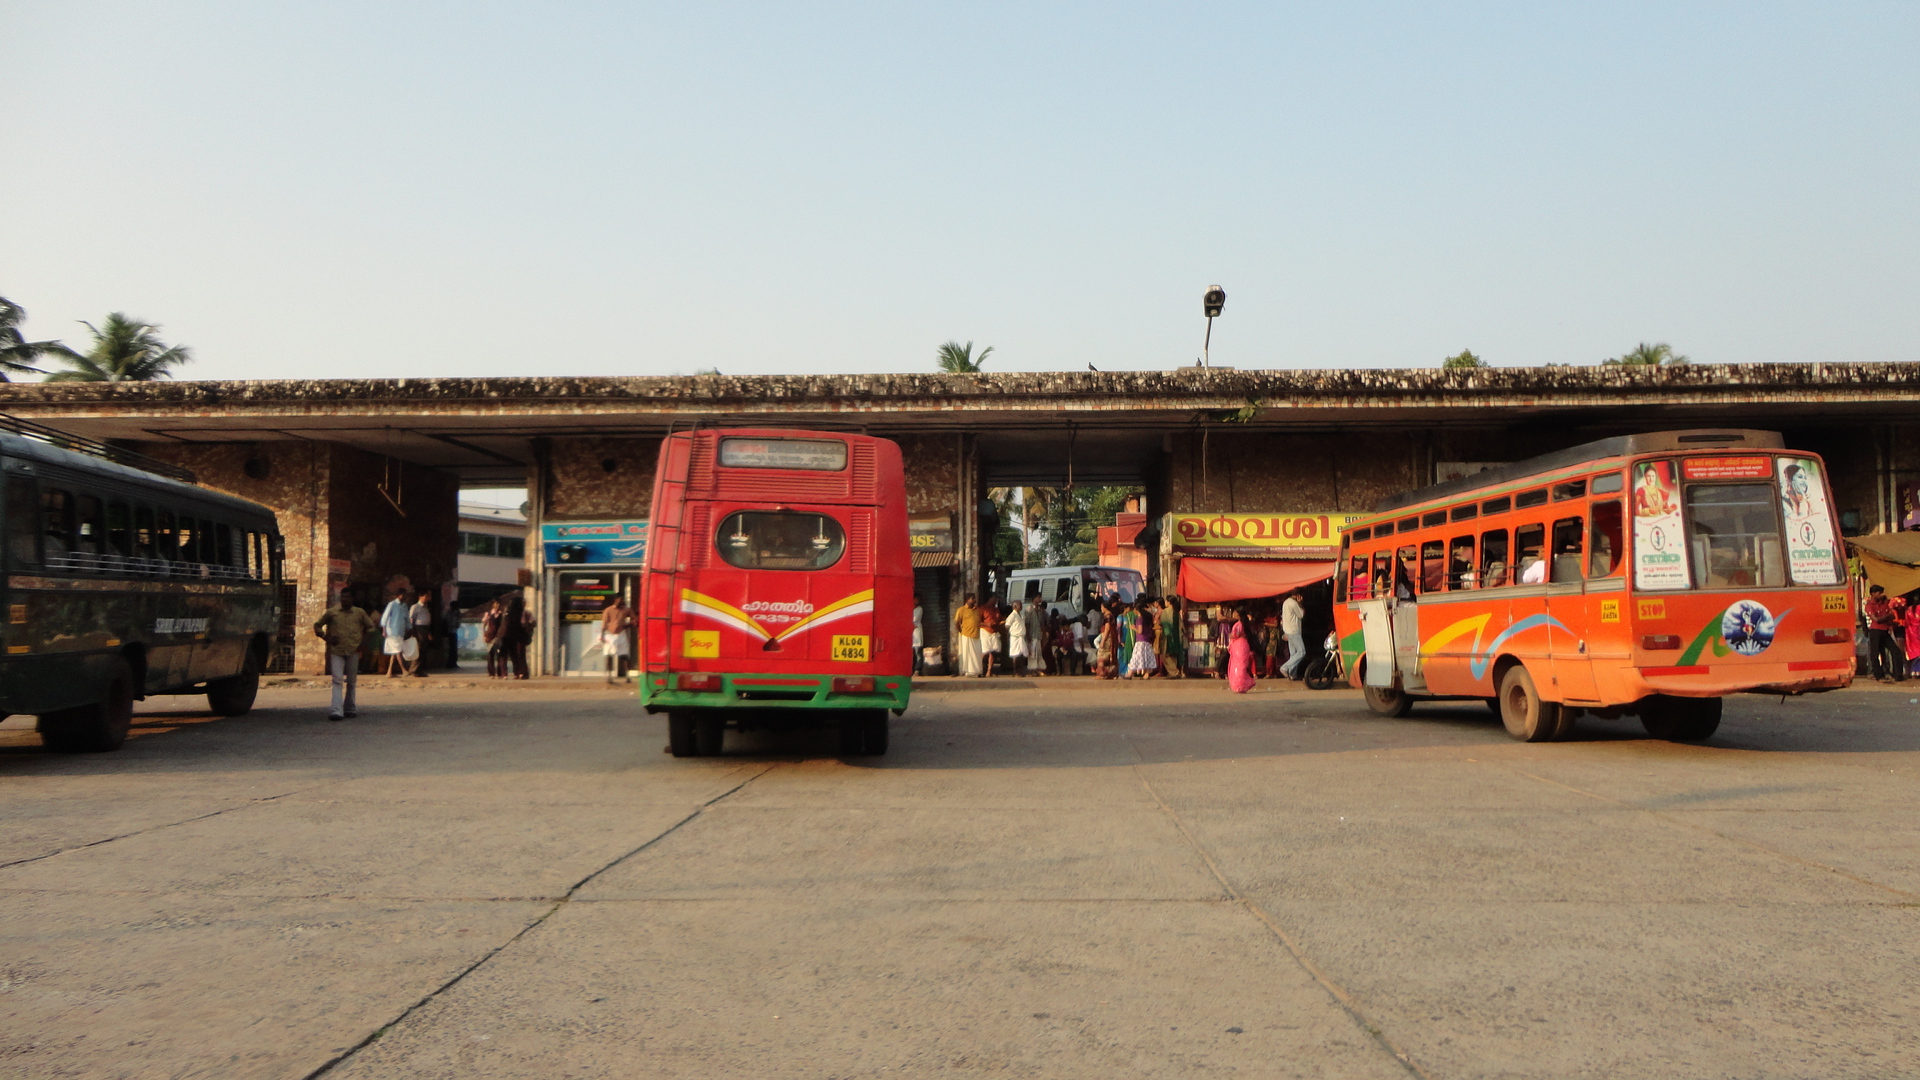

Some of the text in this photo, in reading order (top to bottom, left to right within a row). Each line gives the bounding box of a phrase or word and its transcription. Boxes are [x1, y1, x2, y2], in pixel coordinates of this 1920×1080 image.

[1177, 515, 1330, 543] ഉർവശി
[910, 534, 936, 547] ISE
[742, 599, 814, 613] ഫാത്തിമ
[1640, 604, 1664, 616] STOP
[839, 637, 863, 646] KL04
